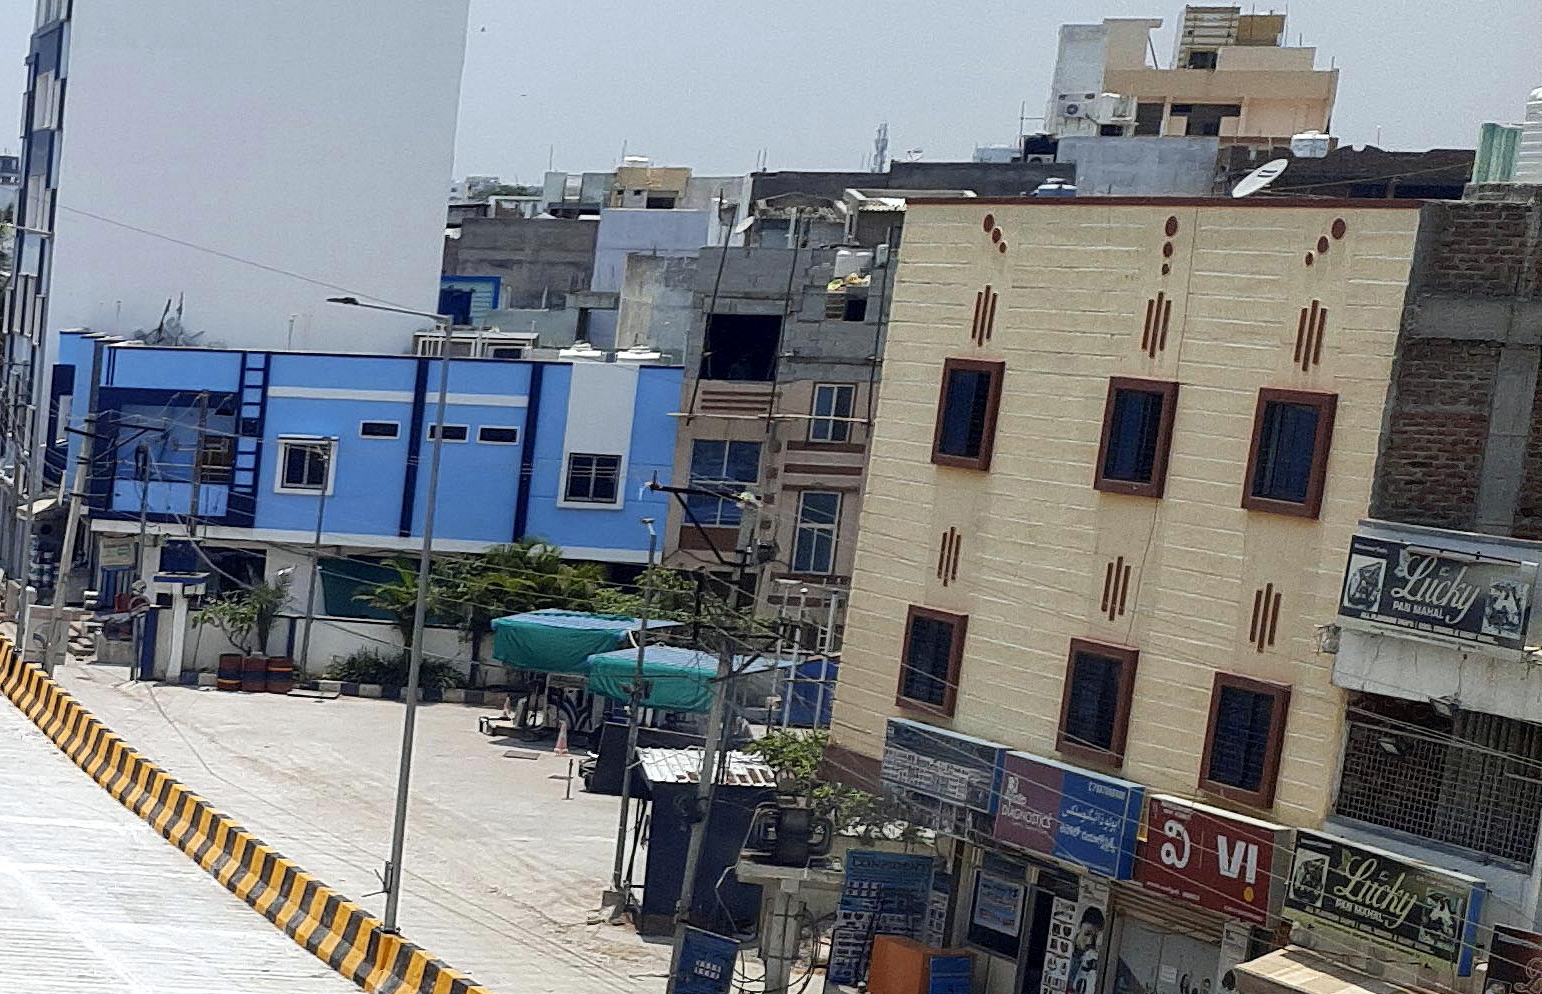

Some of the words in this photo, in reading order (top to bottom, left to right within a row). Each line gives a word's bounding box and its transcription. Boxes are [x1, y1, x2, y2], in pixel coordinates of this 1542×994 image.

[1391, 555, 1481, 624] Lucky
[1217, 834, 1258, 884] VI
[1333, 856, 1418, 929] Lucky
